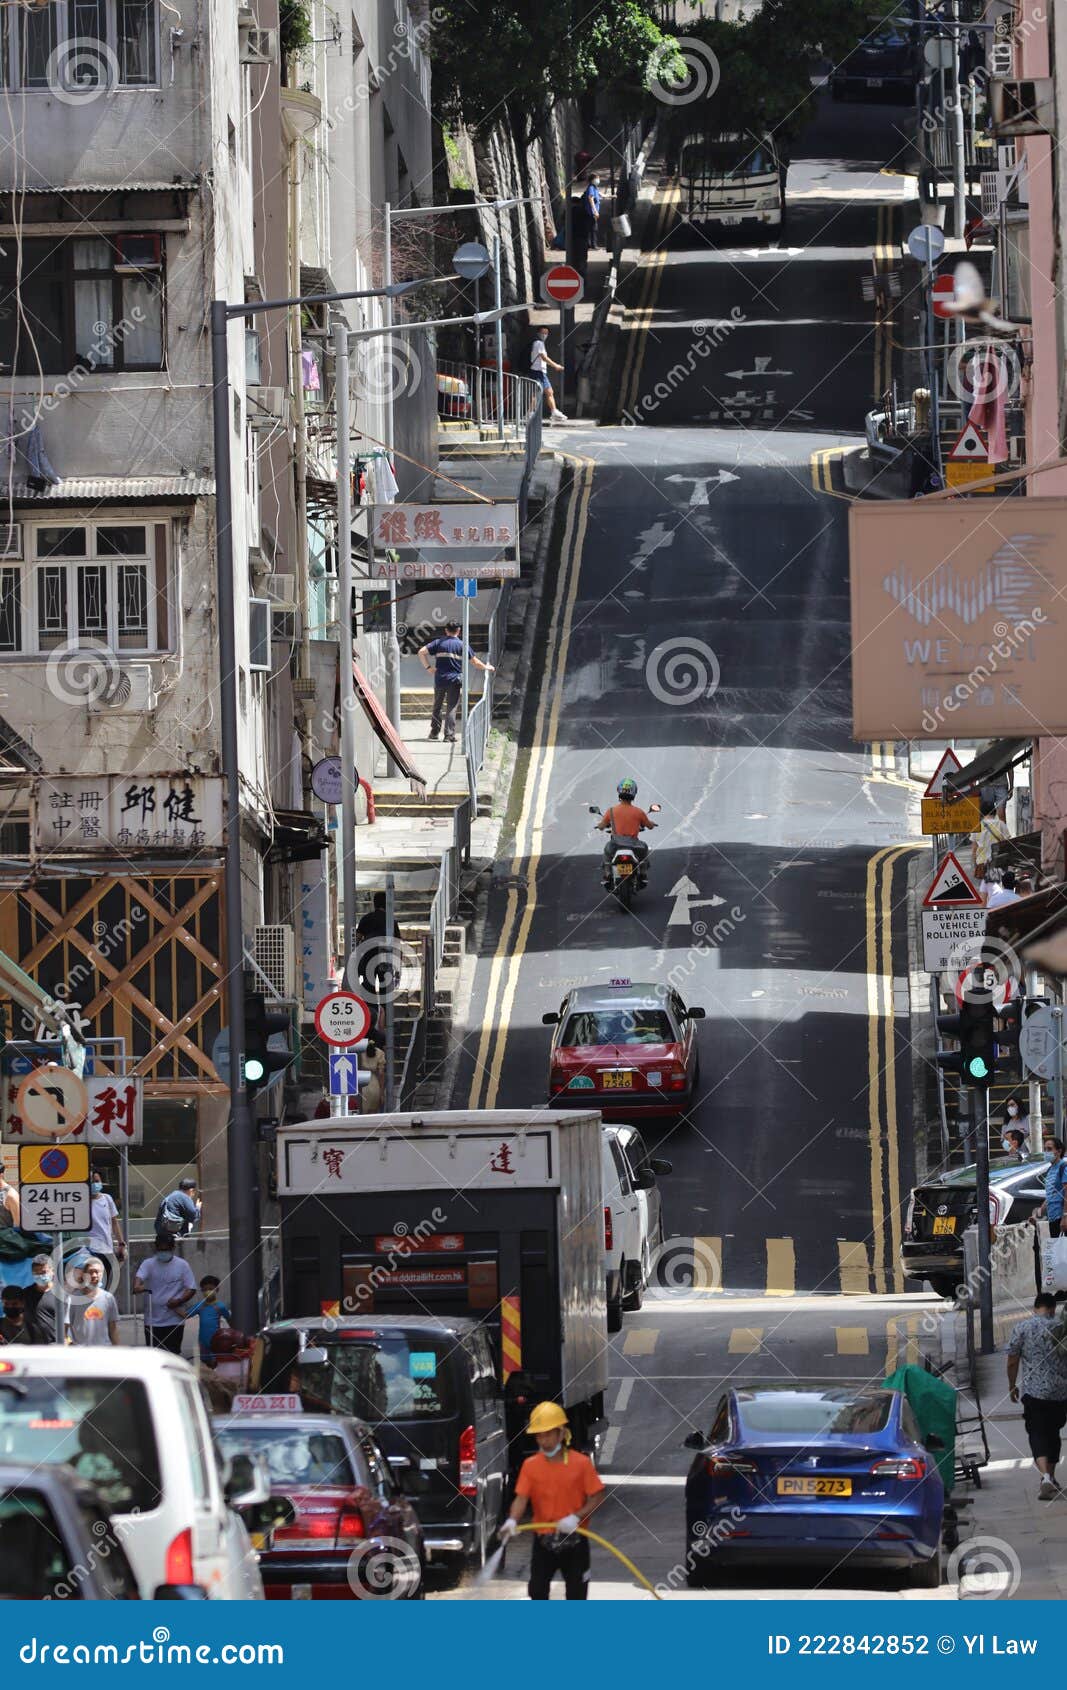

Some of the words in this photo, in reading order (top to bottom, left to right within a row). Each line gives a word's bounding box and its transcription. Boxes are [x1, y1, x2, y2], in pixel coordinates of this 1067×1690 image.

[378, 564, 397, 578] AH
[404, 563, 426, 577] CHI
[903, 638, 951, 664] WE
[50, 790, 103, 811] 註冊
[121, 784, 203, 825] 邱健
[52, 814, 102, 838] 中醫
[933, 913, 971, 921] BEWARE
[940, 921, 979, 930] VEHICLE
[927, 931, 966, 939] ROLLING
[331, 1002, 353, 1015] 5.5
[27, 1189, 50, 1202] 24
[54, 1188, 82, 1202] hrs
[36, 1207, 75, 1225] 全日
[238, 1396, 296, 1408] TAXI
[783, 1480, 803, 1492] PN
[807, 1480, 845, 1492] 5273
